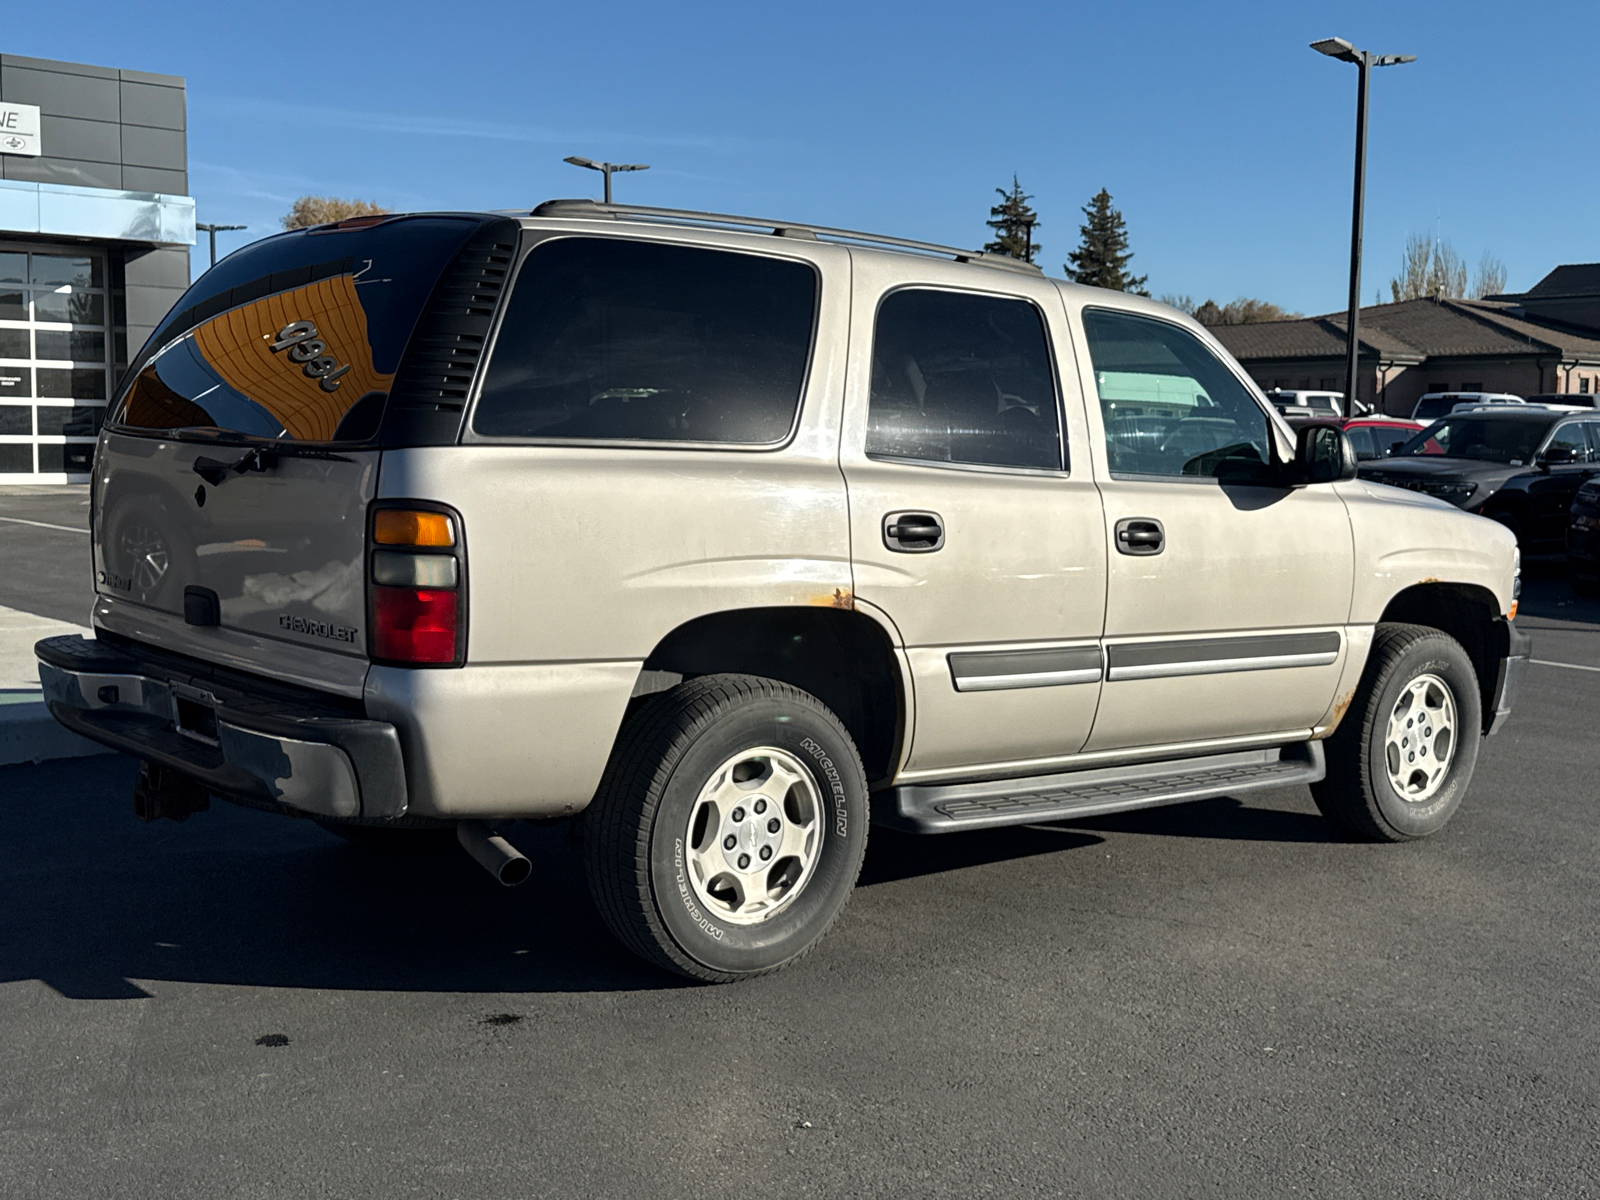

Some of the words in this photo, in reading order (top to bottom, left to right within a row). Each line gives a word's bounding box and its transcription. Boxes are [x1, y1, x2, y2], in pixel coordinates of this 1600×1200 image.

[279, 613, 358, 643] CHEVROLET
[800, 737, 847, 837] MICHELIN
[675, 838, 723, 940] MICHELIN
